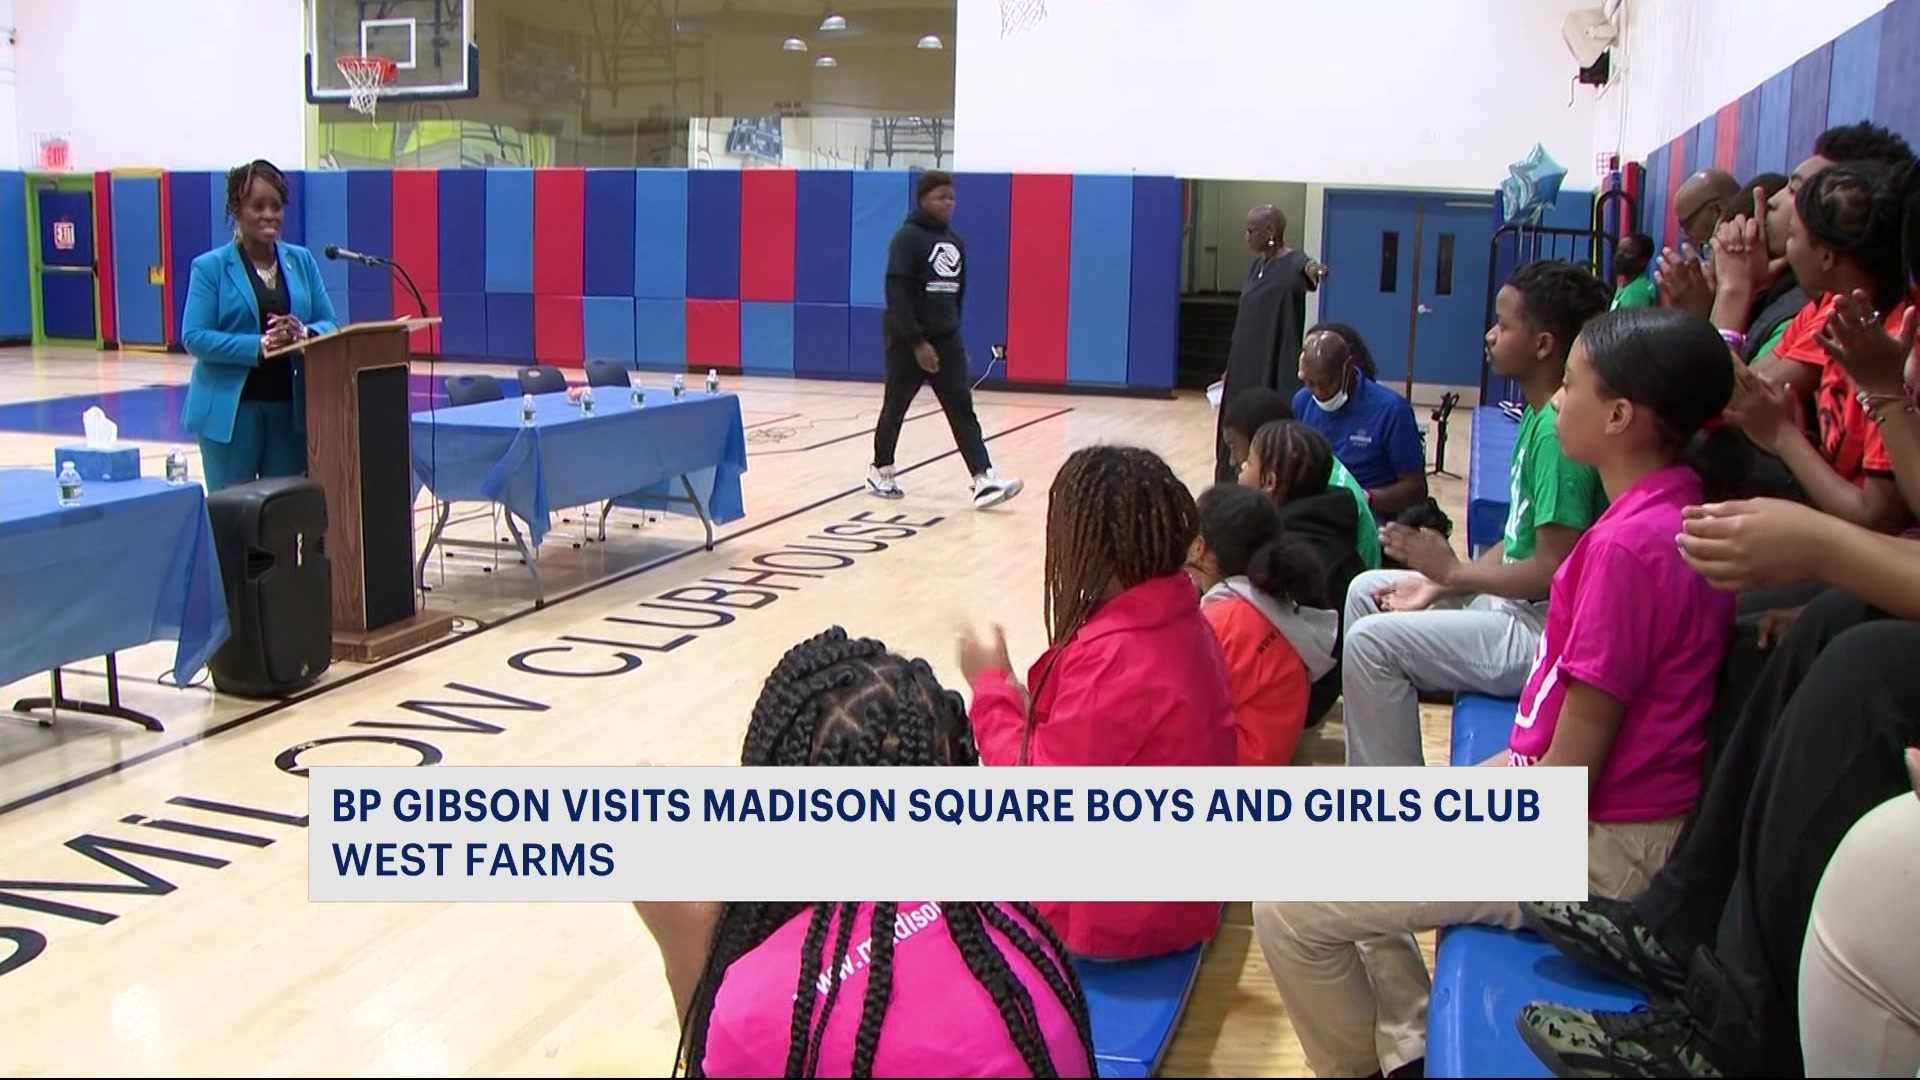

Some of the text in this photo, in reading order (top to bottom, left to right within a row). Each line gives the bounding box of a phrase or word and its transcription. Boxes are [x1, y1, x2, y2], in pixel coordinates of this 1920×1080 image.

[46, 145, 66, 168] EXIT
[55, 224, 73, 244] EXIT
[507, 510, 946, 679] CLUBHOUSE
